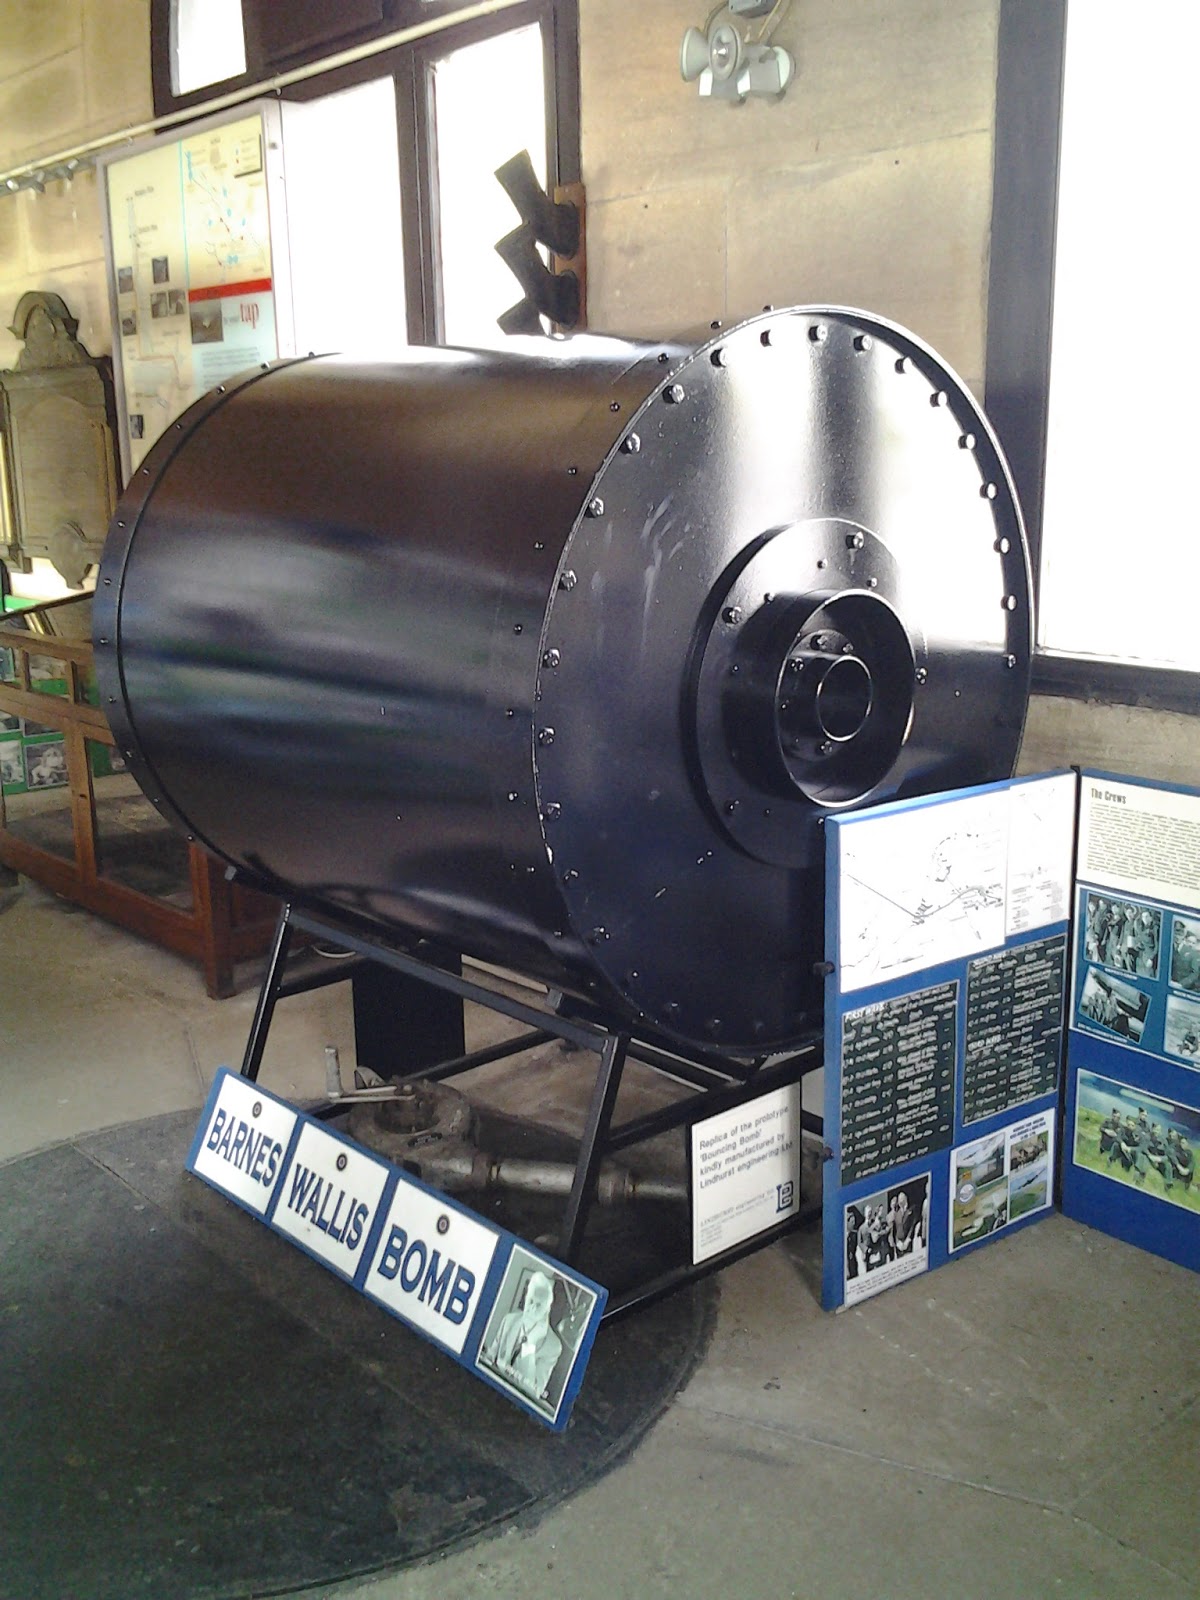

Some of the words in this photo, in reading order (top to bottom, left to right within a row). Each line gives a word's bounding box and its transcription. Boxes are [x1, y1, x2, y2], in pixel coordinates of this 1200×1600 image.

[1091, 787, 1103, 800] The
[205, 1107, 283, 1188] BARNES
[700, 1132, 728, 1151] Replica
[730, 1125, 739, 1137] of
[740, 1121, 752, 1132] the
[754, 1106, 789, 1128] prototype
[700, 1160, 722, 1176] kindly
[724, 1136, 775, 1165] manufactured
[776, 1133, 785, 1144] by
[700, 1167, 735, 1189] Lindhurst
[737, 1147, 779, 1171] engineering
[287, 1163, 370, 1251] WALLIS
[377, 1223, 476, 1326] BOMB
